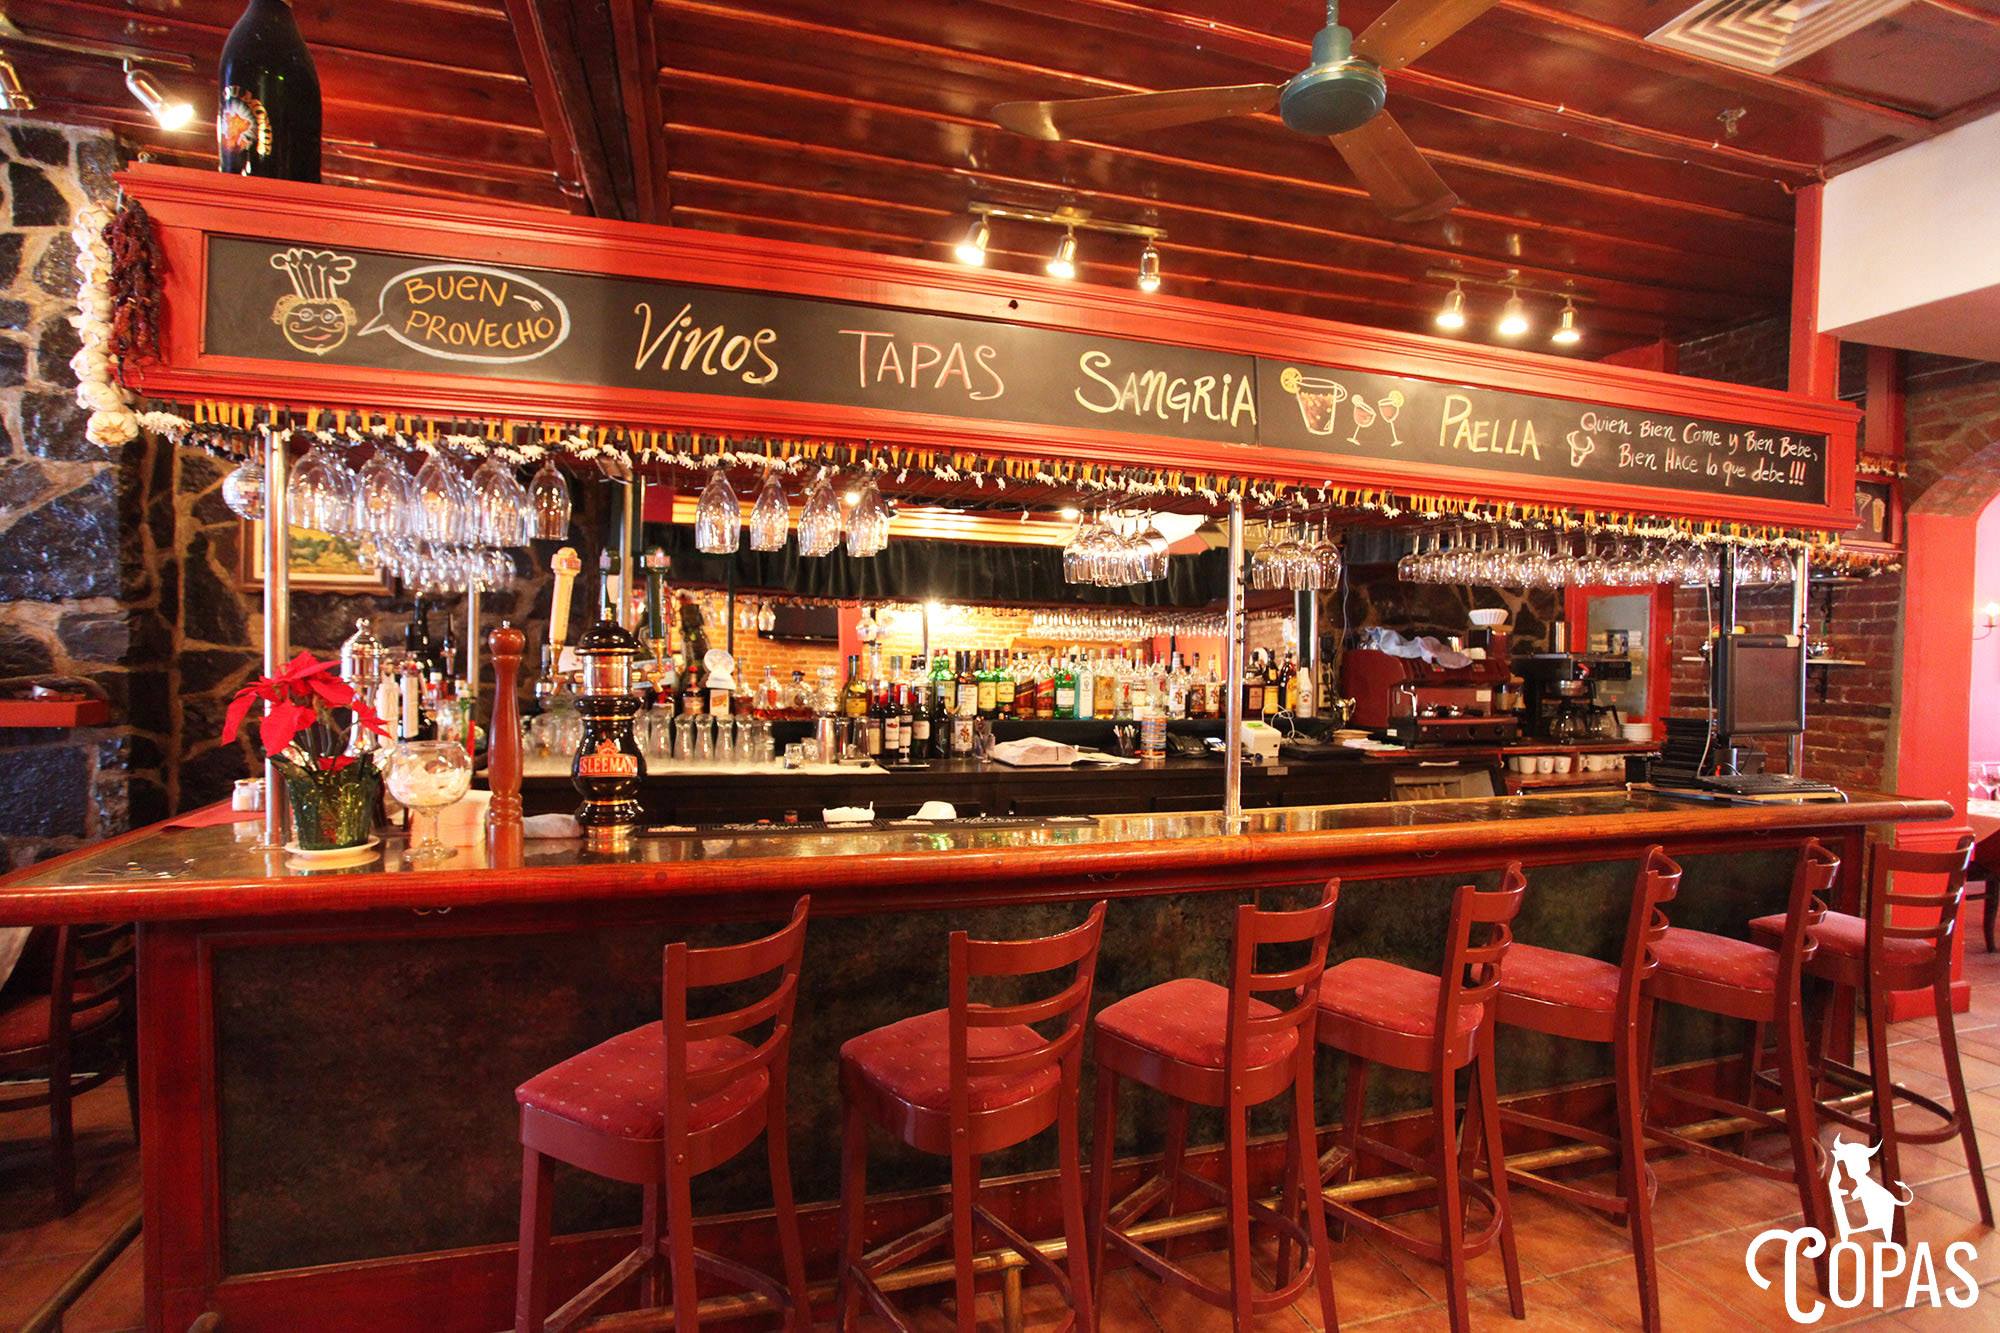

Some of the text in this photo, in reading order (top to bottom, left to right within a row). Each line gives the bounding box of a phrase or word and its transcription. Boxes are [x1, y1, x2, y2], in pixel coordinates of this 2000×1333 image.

[403, 309, 555, 350] PROVECHO
[633, 302, 779, 384] Vinos
[839, 328, 1005, 400] TAPAS
[1439, 393, 1541, 461] PAELLA
[1580, 411, 1632, 436] Quien
[1682, 422, 1722, 446] Come
[1722, 460, 1747, 487] que
[1751, 457, 1785, 484] debe
[582, 757, 636, 773] SLEEMAN
